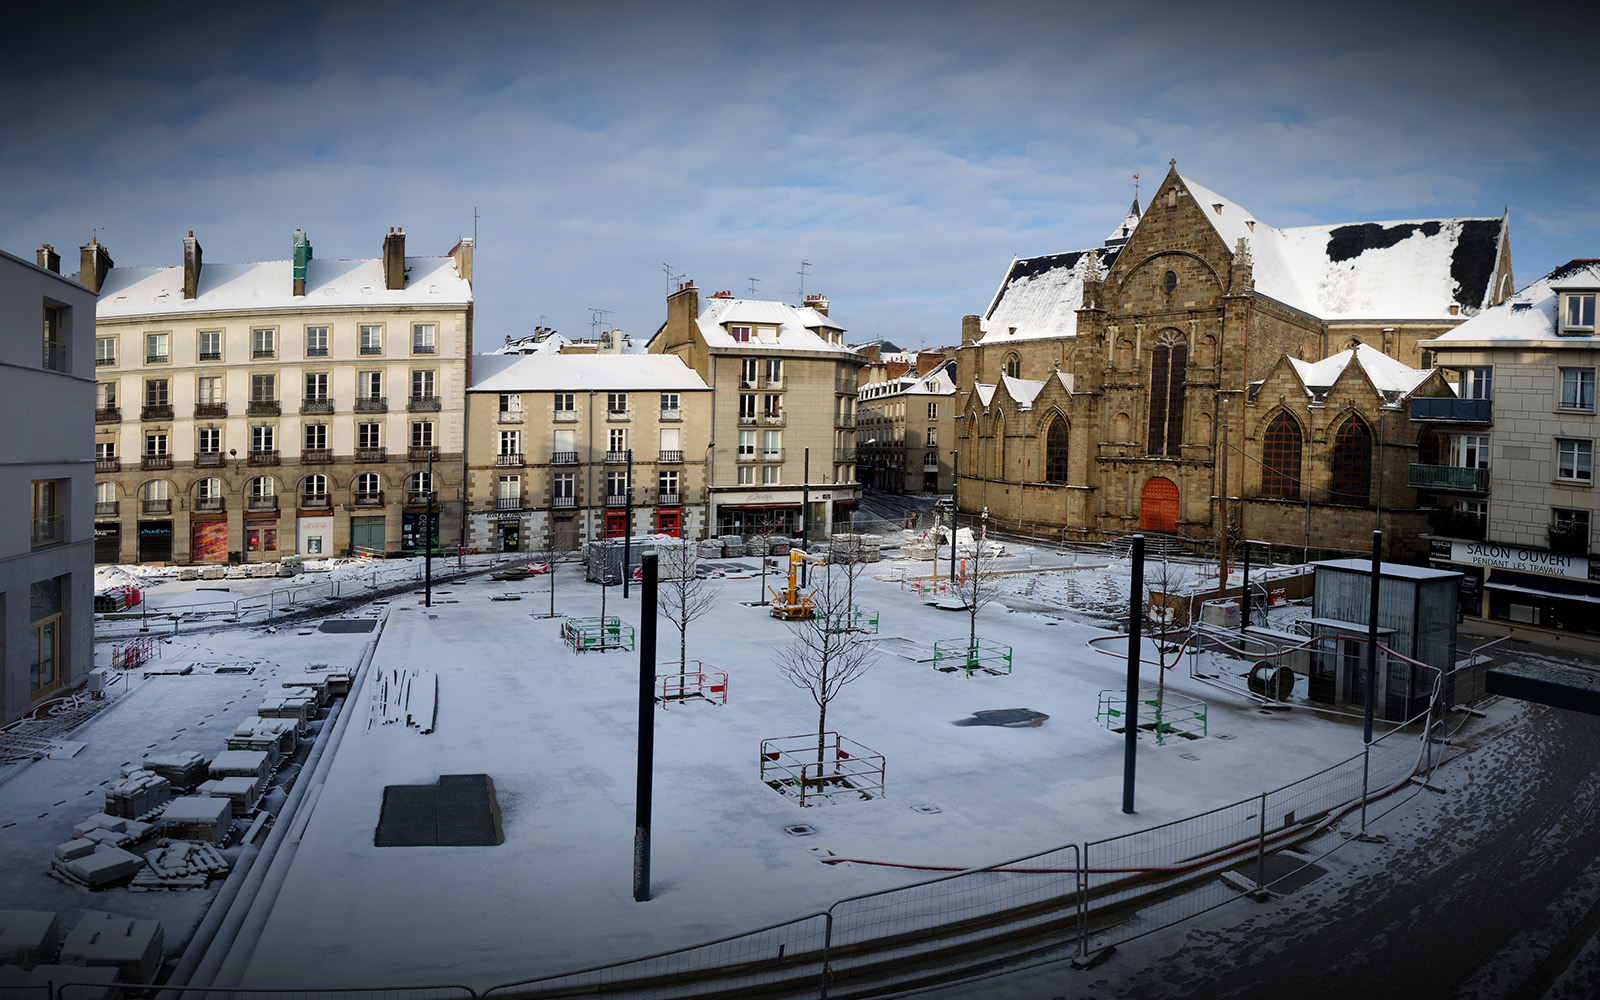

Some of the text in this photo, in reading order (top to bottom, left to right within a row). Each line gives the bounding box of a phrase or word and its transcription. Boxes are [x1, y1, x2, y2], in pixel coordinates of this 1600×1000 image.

[1467, 543, 1511, 559] SALON
[1517, 549, 1575, 567] OUVERT
[1472, 556, 1565, 576] PENDANT LES TRAVAUX
